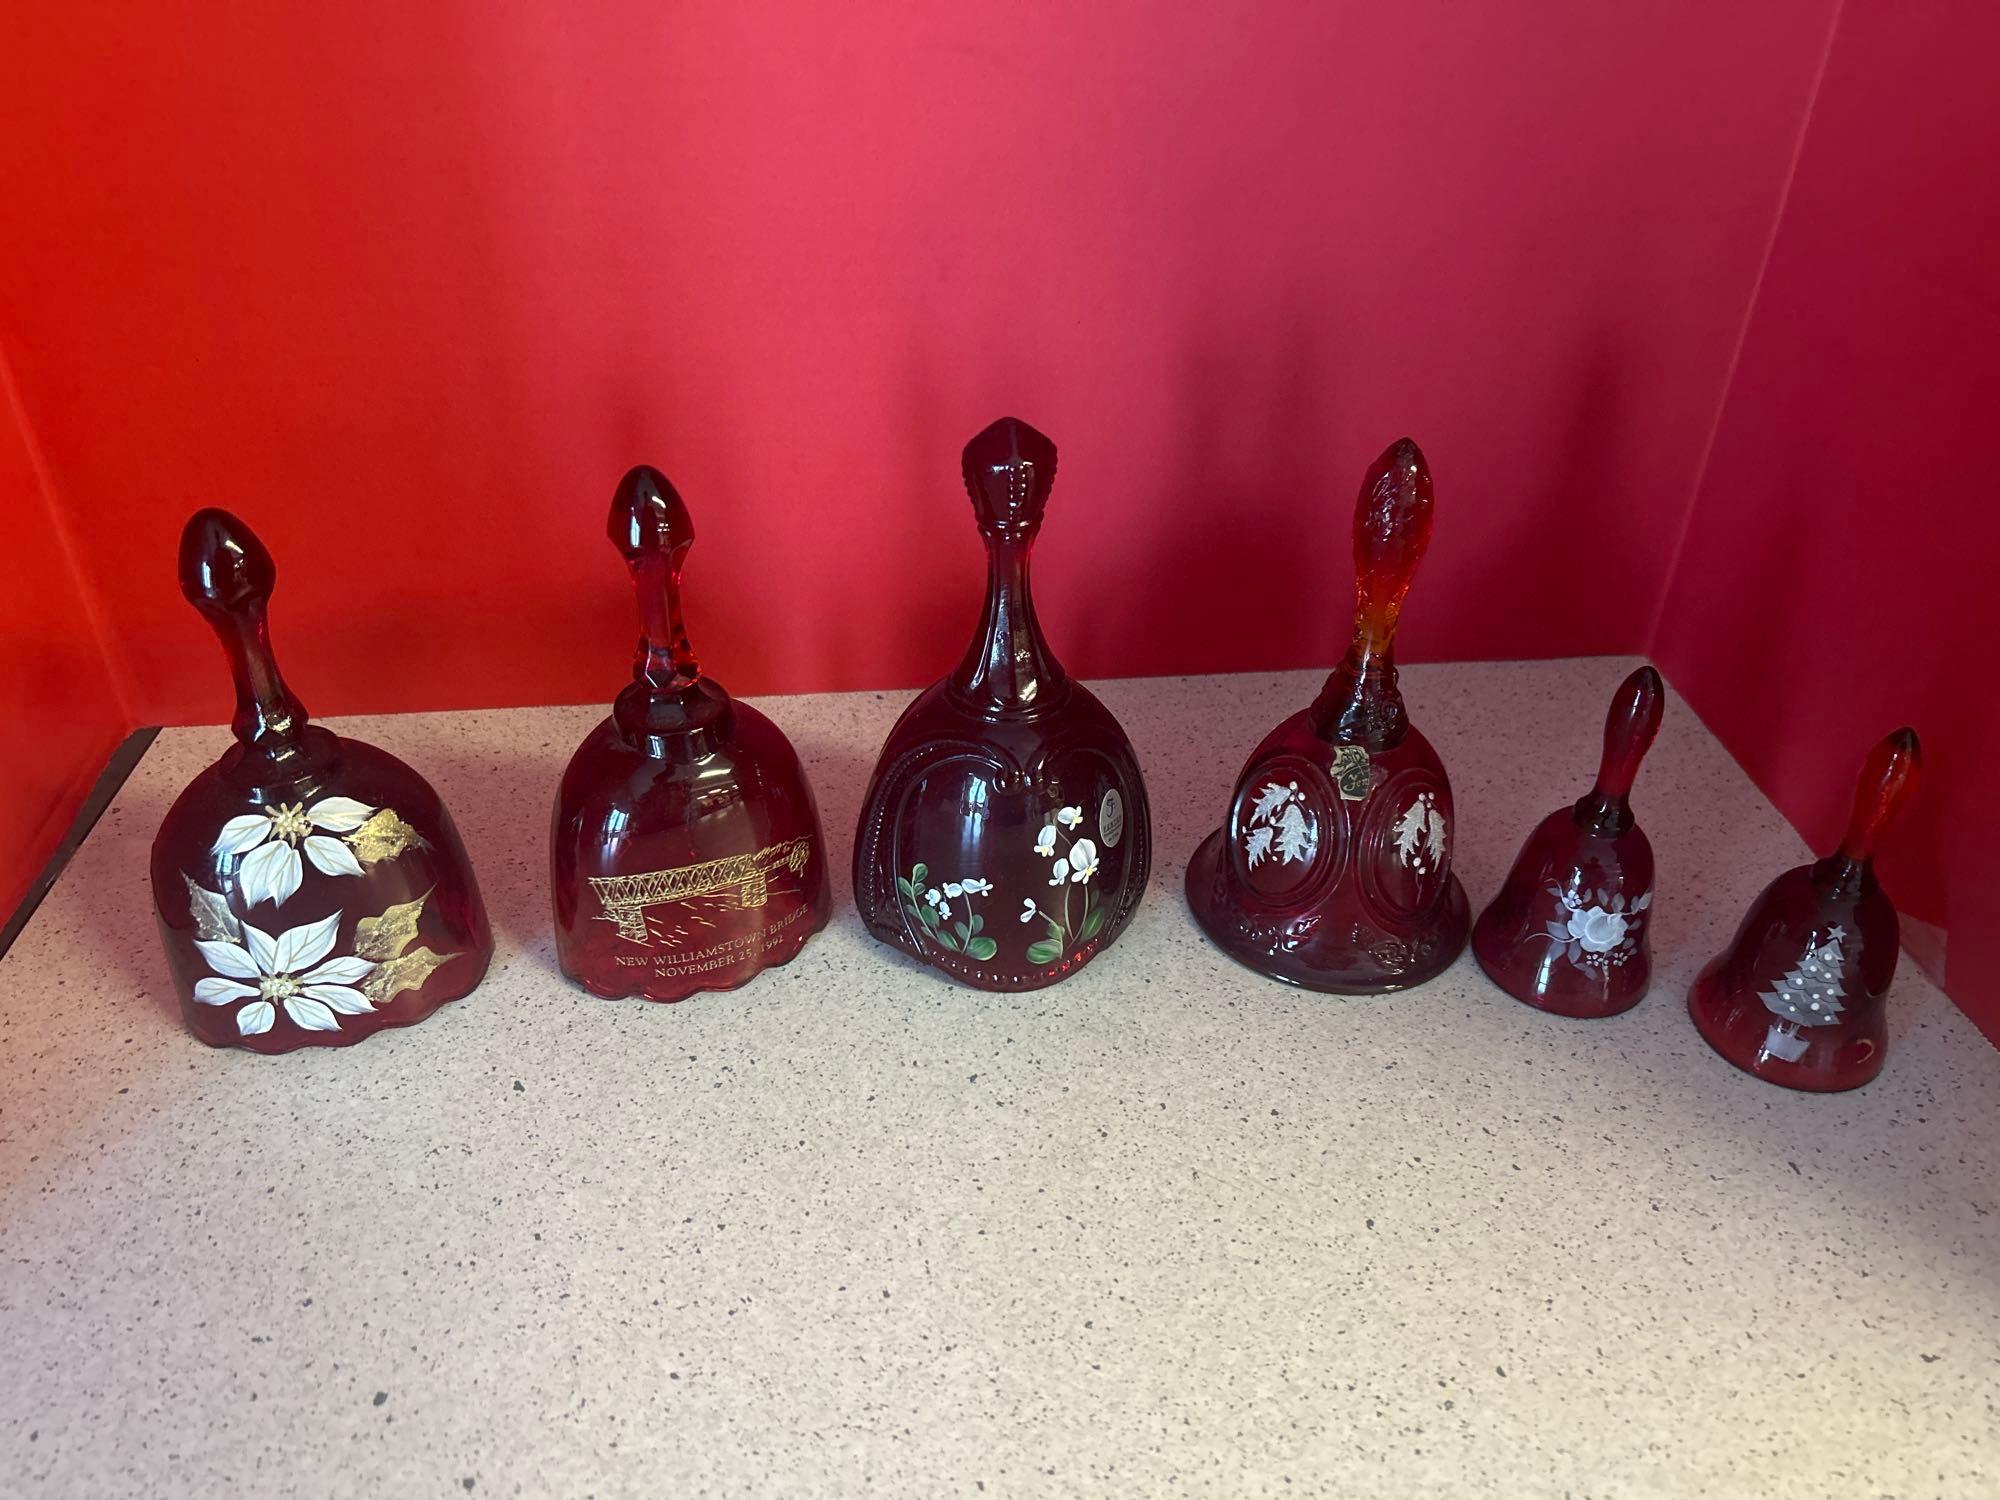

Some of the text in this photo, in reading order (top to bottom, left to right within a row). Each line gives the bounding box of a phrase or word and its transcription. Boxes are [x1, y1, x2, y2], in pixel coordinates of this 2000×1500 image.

[615, 903, 809, 967] NEW WILLIAMSTOWN BRIDGE
[655, 934, 784, 977] NOVEMBER 25, 1992
